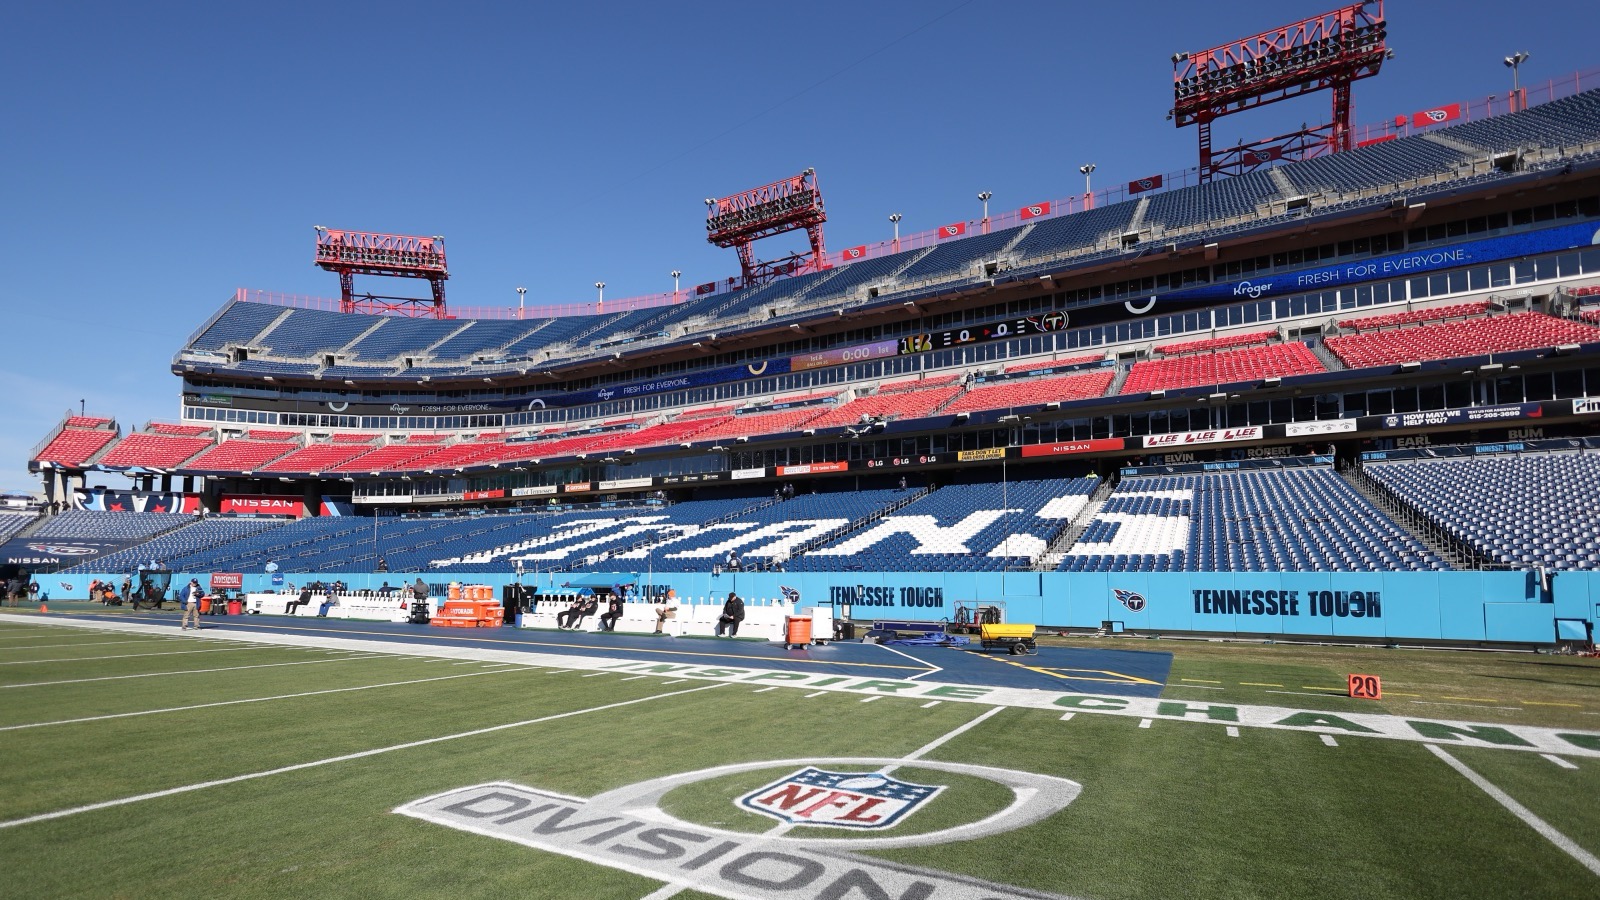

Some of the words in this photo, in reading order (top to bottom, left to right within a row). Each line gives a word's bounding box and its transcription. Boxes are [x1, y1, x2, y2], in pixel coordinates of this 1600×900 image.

[1298, 270, 1339, 286] FRESH
[1347, 264, 1376, 281] FOR
[1233, 281, 1272, 298] Kroger
[842, 347, 870, 361] 0:00
[877, 346, 890, 355] 1st
[623, 385, 640, 394] FRESH
[642, 383, 655, 391] FOR
[598, 389, 614, 400] Kroger
[390, 404, 409, 414] Kroger
[1403, 413, 1425, 421] HOW
[1425, 417, 1448, 425] YOU?
[1196, 431, 1217, 440] LEE
[1236, 428, 1258, 436] LEE
[1508, 428, 1543, 439] BUM
[1159, 435, 1179, 443] LEE
[1397, 437, 1431, 447] EARL
[1053, 444, 1090, 452] NISSAN
[1248, 446, 1291, 457] ROBERT
[1164, 453, 1194, 462] ELVIN
[231, 498, 293, 508] NISSAN
[829, 586, 895, 607] TENNESSEE
[899, 585, 944, 608] TOUGH
[1192, 589, 1299, 616] TENNESSEE
[1308, 590, 1382, 618] TOUGH
[597, 662, 995, 699] INSPIRE
[1351, 676, 1378, 698] 20
[757, 784, 893, 824] NFL
